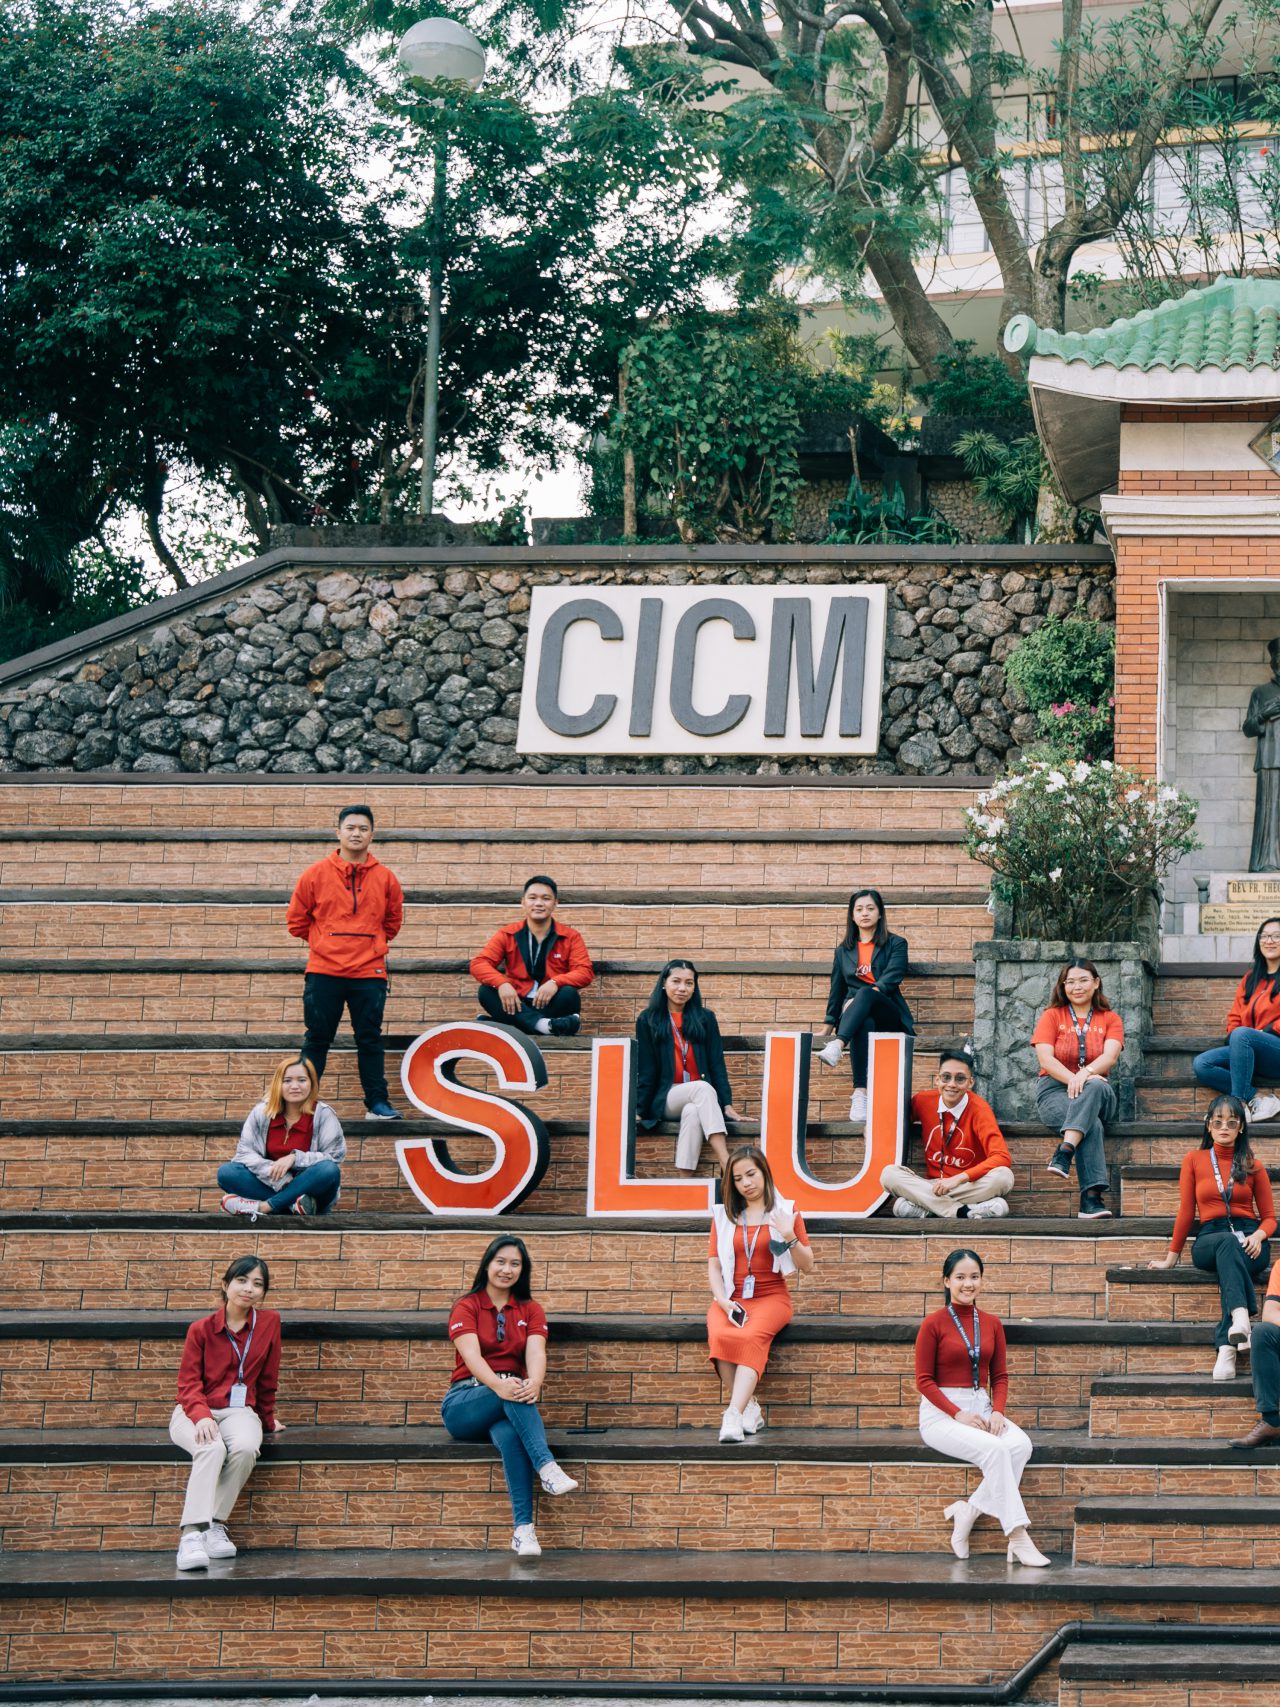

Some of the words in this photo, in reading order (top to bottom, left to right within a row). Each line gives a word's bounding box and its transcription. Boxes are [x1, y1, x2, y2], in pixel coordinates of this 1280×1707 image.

[535, 597, 869, 738] CICM
[1249, 882, 1261, 894] FR.
[396, 1022, 912, 1219] SLU
